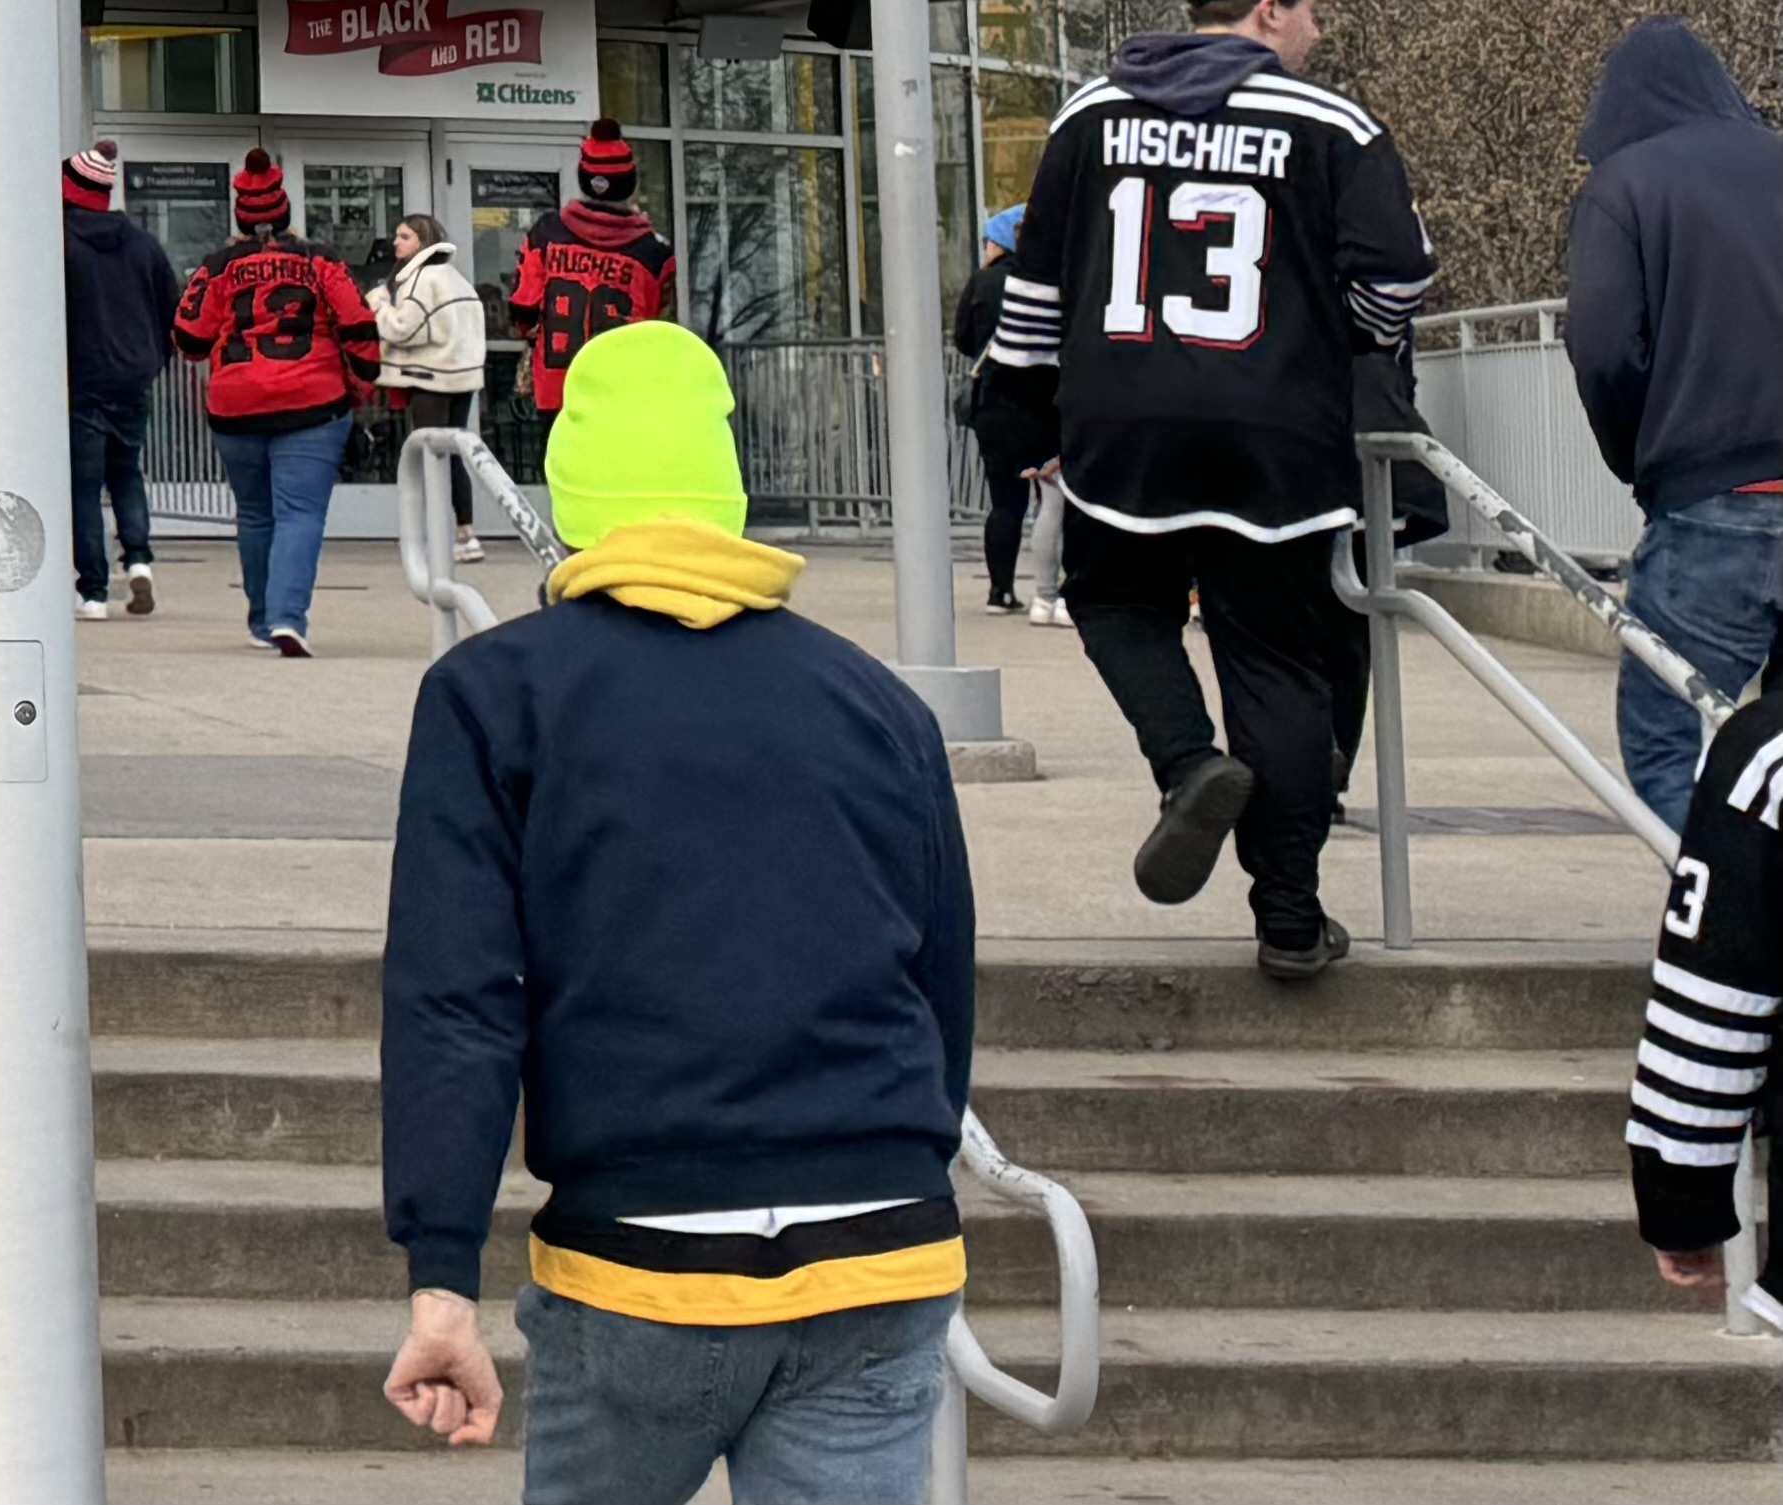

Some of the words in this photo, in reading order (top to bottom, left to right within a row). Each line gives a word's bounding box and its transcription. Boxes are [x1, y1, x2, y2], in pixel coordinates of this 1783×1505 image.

[307, 18, 334, 41] THE
[430, 44, 458, 68] AND
[465, 18, 522, 60] RED
[496, 82, 577, 105] Citizens
[1102, 117, 1292, 179] HISCHIER
[546, 248, 634, 285] HUGHES
[1102, 176, 1273, 352] 13
[221, 284, 318, 363] 13
